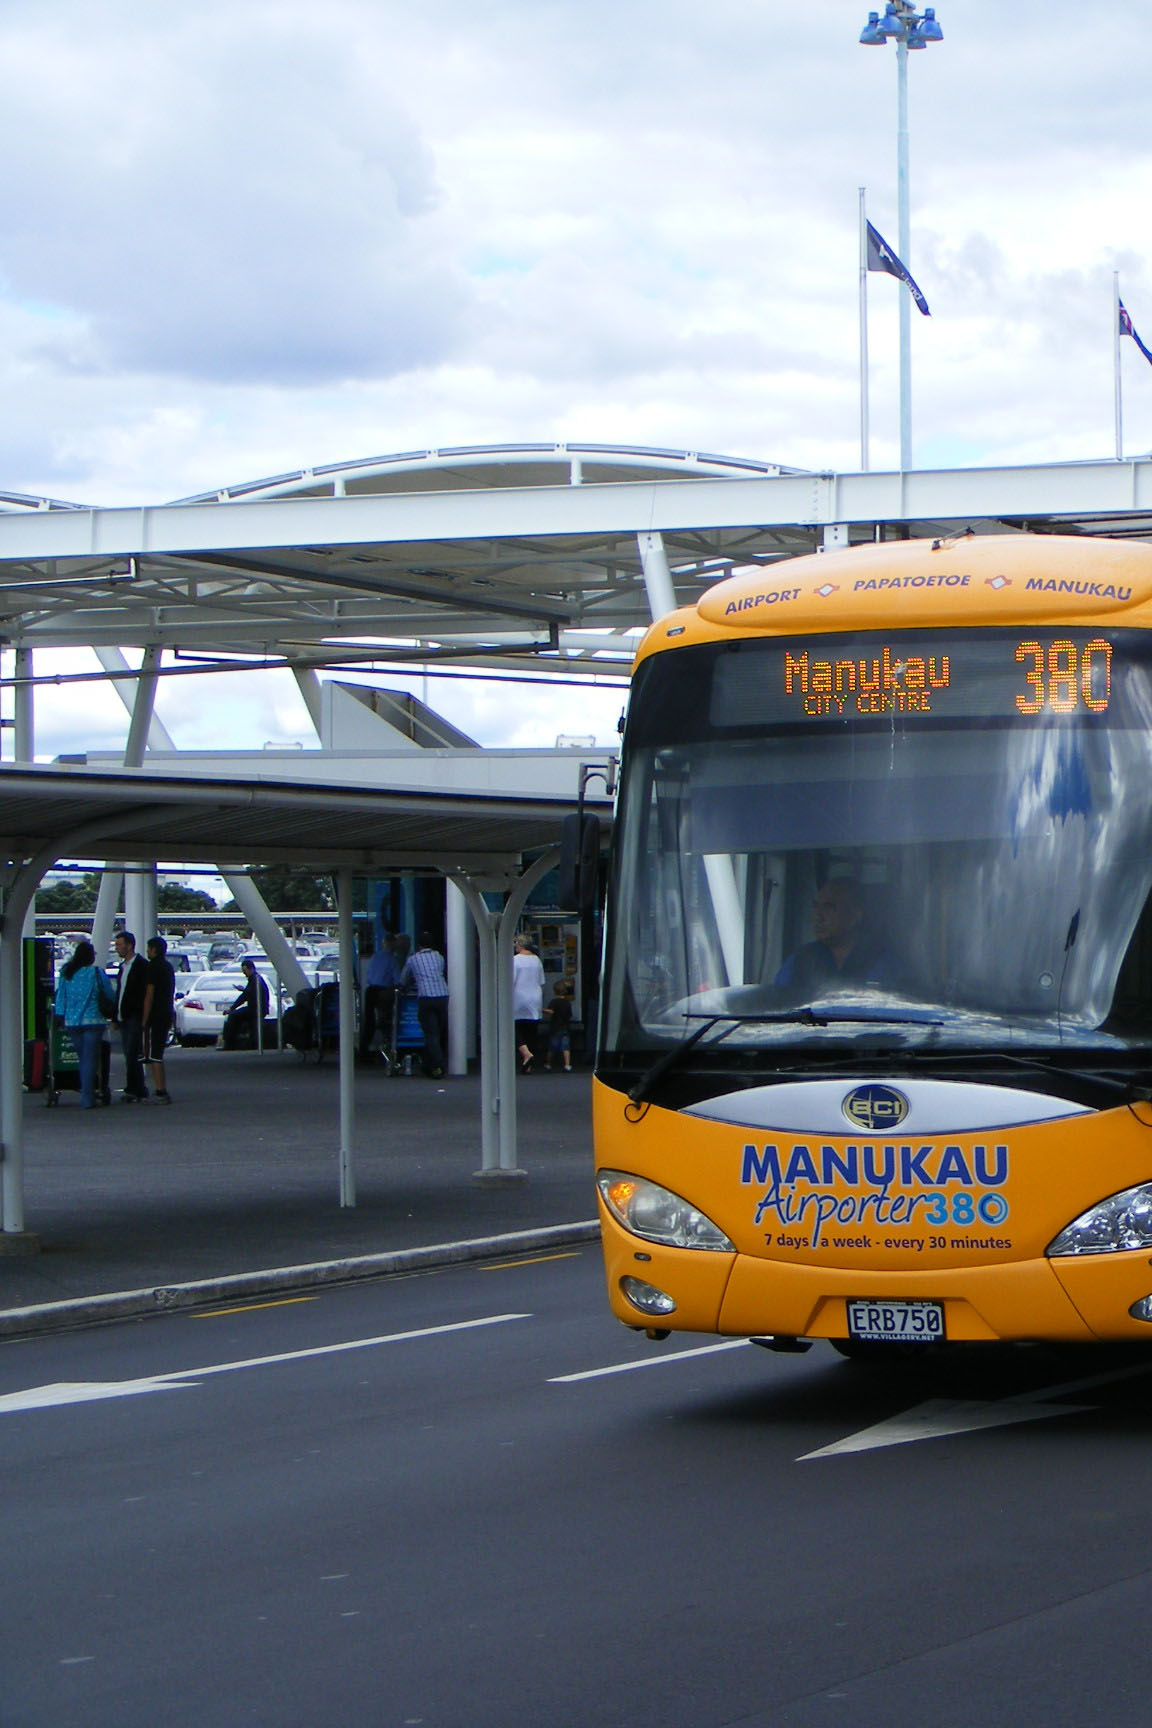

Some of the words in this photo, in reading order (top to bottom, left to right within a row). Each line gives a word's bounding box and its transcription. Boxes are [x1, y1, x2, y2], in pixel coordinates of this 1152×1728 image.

[725, 588, 801, 615] AIRPORT
[854, 574, 971, 591] PAPATOETOE
[1025, 577, 1132, 600] MANUKAU
[784, 646, 950, 694] Manukau
[1014, 637, 1113, 714] 380
[803, 694, 848, 715] CITY
[855, 691, 932, 713] CENTRE
[852, 1101, 900, 1115] BCI
[741, 1145, 1008, 1186] MANUKAU
[764, 1234, 773, 1246] 7
[777, 1234, 809, 1249] days
[820, 1237, 829, 1248] a
[833, 1236, 872, 1248] week
[884, 1238, 924, 1251] every
[929, 1236, 946, 1248] 30
[951, 1236, 1011, 1249] minutes
[853, 1308, 940, 1332] ERB750
